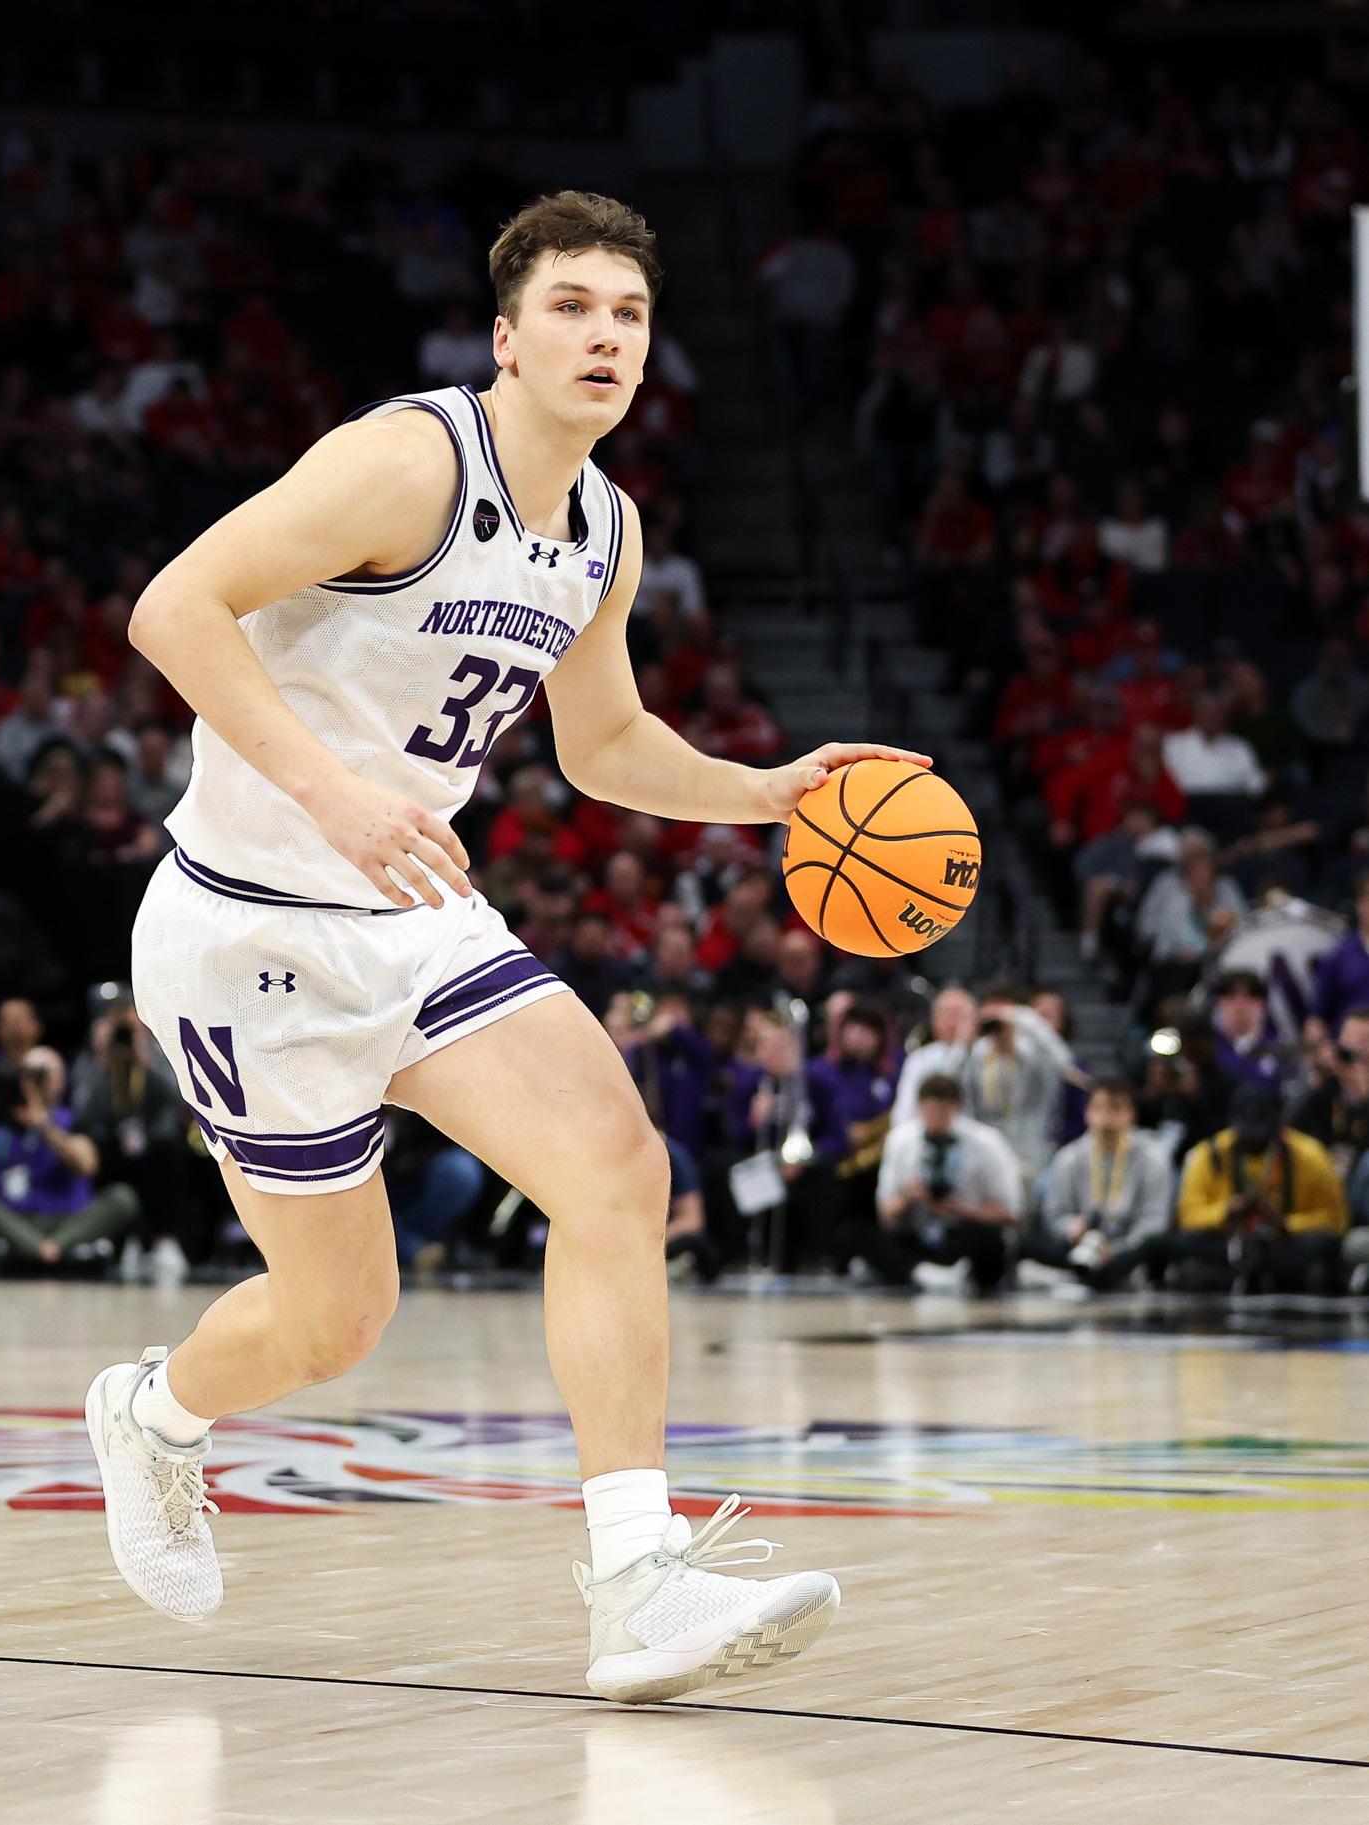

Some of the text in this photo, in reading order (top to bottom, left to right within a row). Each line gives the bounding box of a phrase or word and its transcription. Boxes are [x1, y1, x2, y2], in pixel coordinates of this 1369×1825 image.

[418, 600, 579, 660] NORTHWESTER
[404, 654, 540, 768] 33
[944, 858, 981, 889] CAA
[178, 1016, 247, 1117] N
